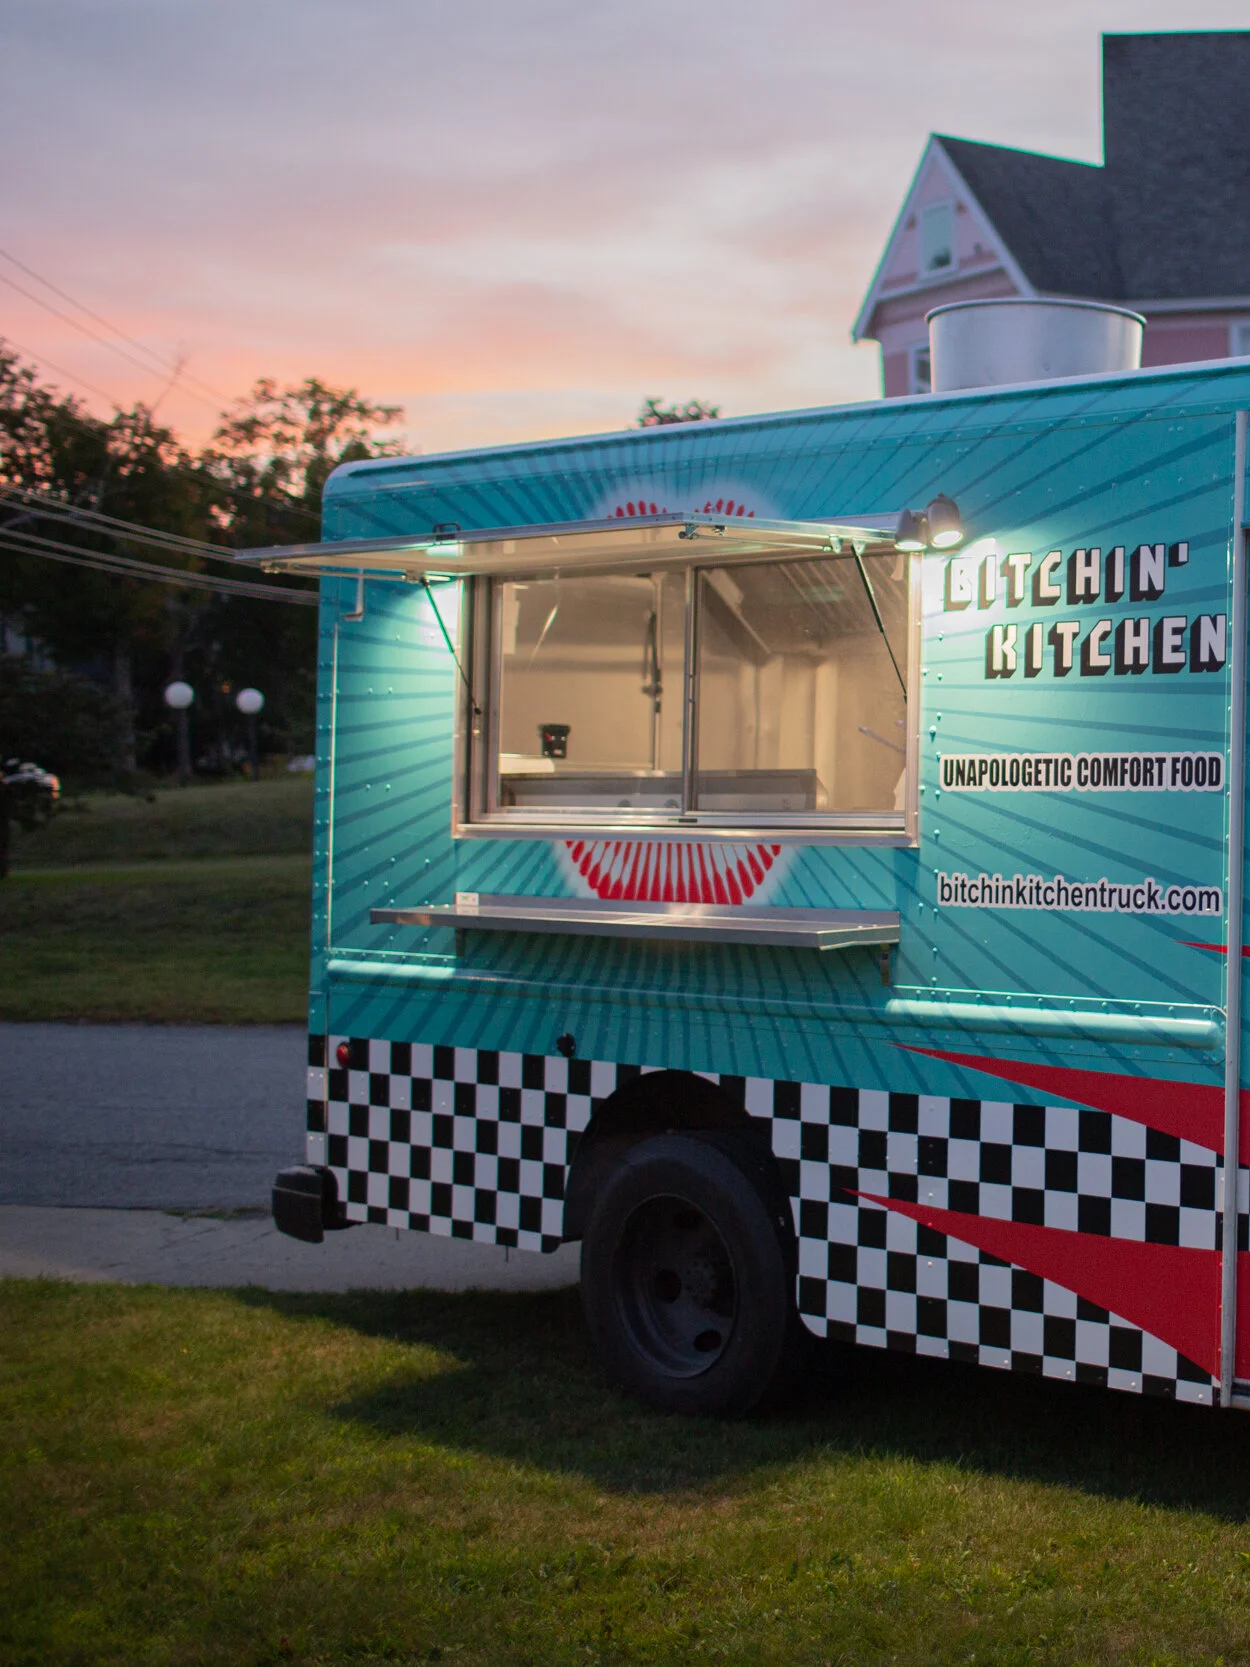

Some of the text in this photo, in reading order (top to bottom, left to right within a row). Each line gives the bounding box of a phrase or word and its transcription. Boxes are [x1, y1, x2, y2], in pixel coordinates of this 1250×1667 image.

[943, 541, 1190, 612] BITCHIN'
[985, 613, 1227, 680] KITCHEN
[943, 755, 1221, 788] UNAPOLOGETIC COMFORT FOOD
[940, 876, 1220, 912] bitchinkitchentruck.com
